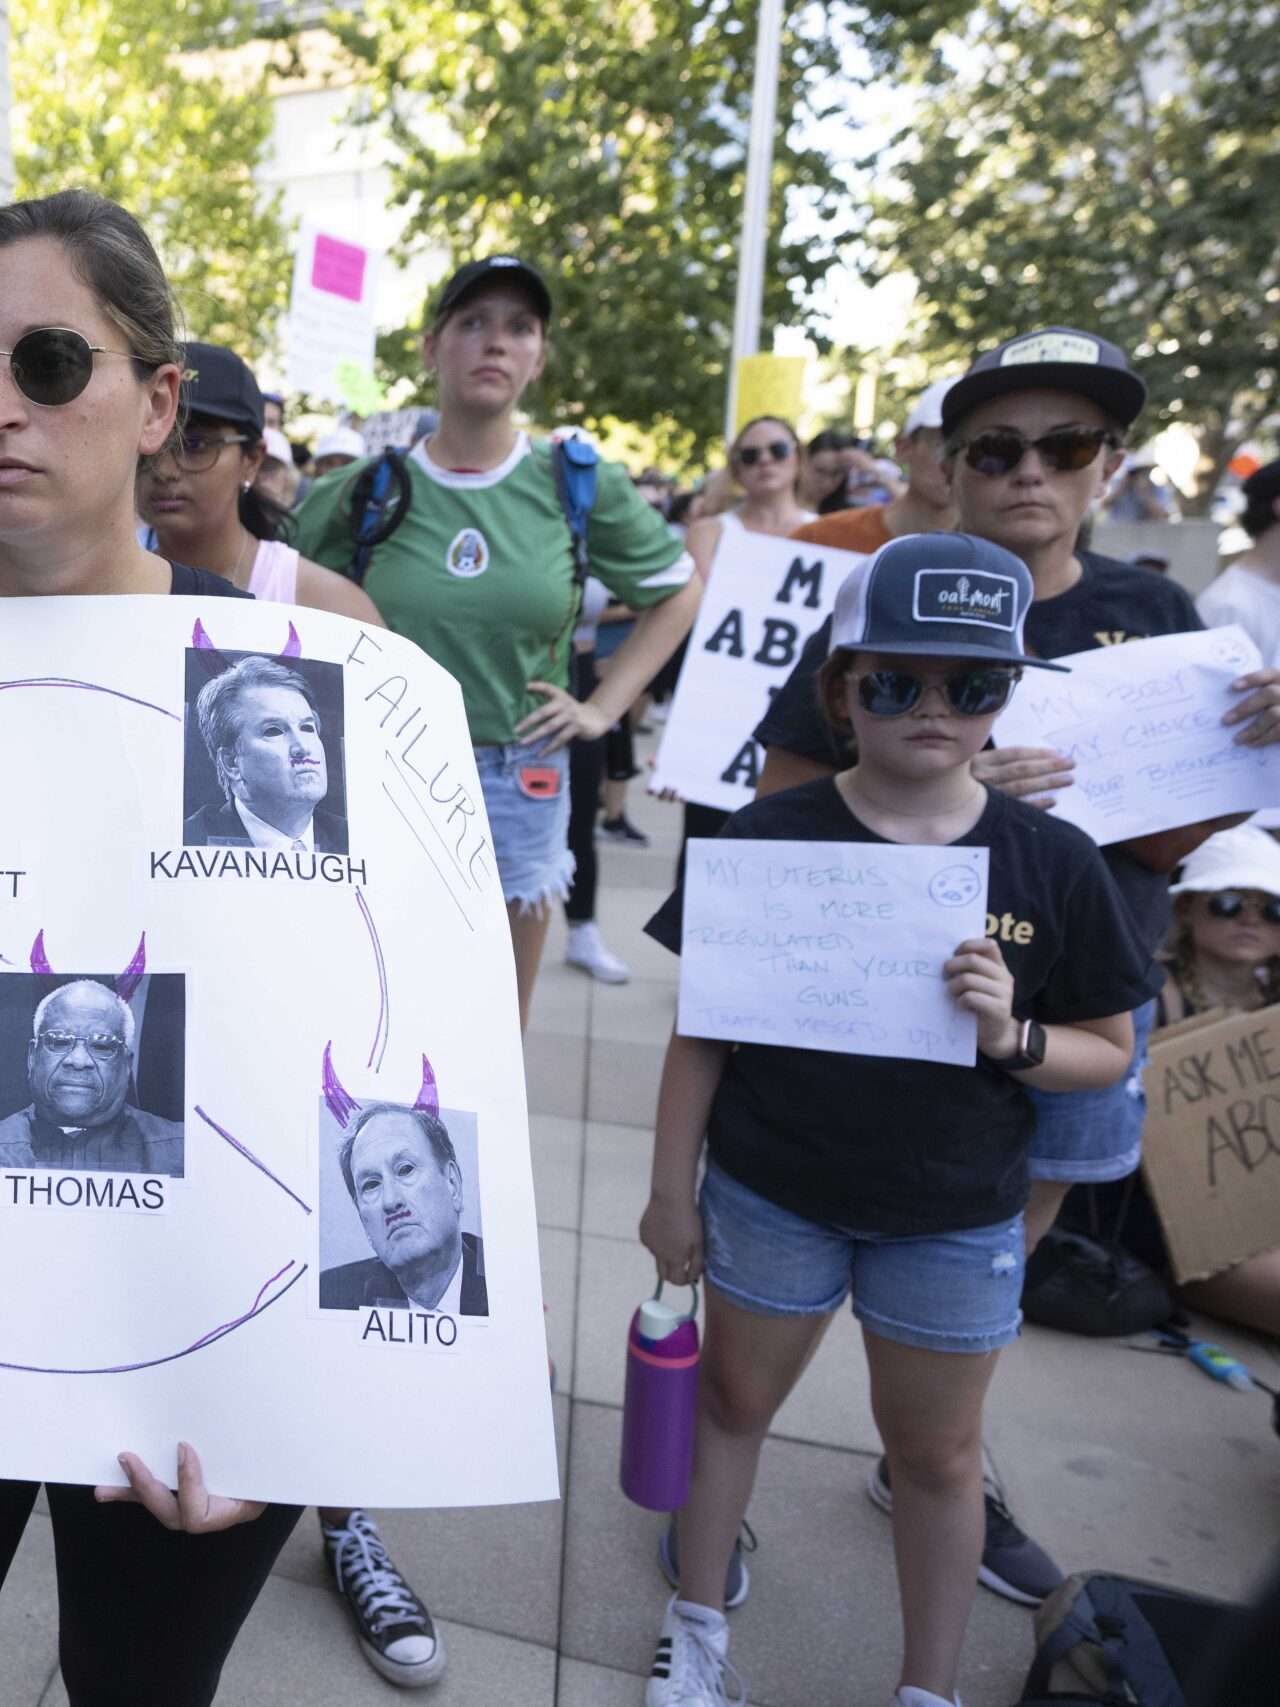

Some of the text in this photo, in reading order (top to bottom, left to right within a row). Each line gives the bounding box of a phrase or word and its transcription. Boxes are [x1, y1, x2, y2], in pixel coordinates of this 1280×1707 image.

[347, 630, 494, 893] FAILURE
[150, 849, 367, 886] KAVANAUGH
[705, 857, 889, 889] MY UTERUS
[763, 895, 896, 921] IS MORE
[687, 925, 855, 951] REGULATED
[986, 912, 1034, 944] ote
[759, 949, 940, 981] THAN YOUR
[1164, 1027, 1280, 1116] ASK ME
[5, 1175, 165, 1210] THOMAS
[362, 1309, 458, 1347] ALITO
